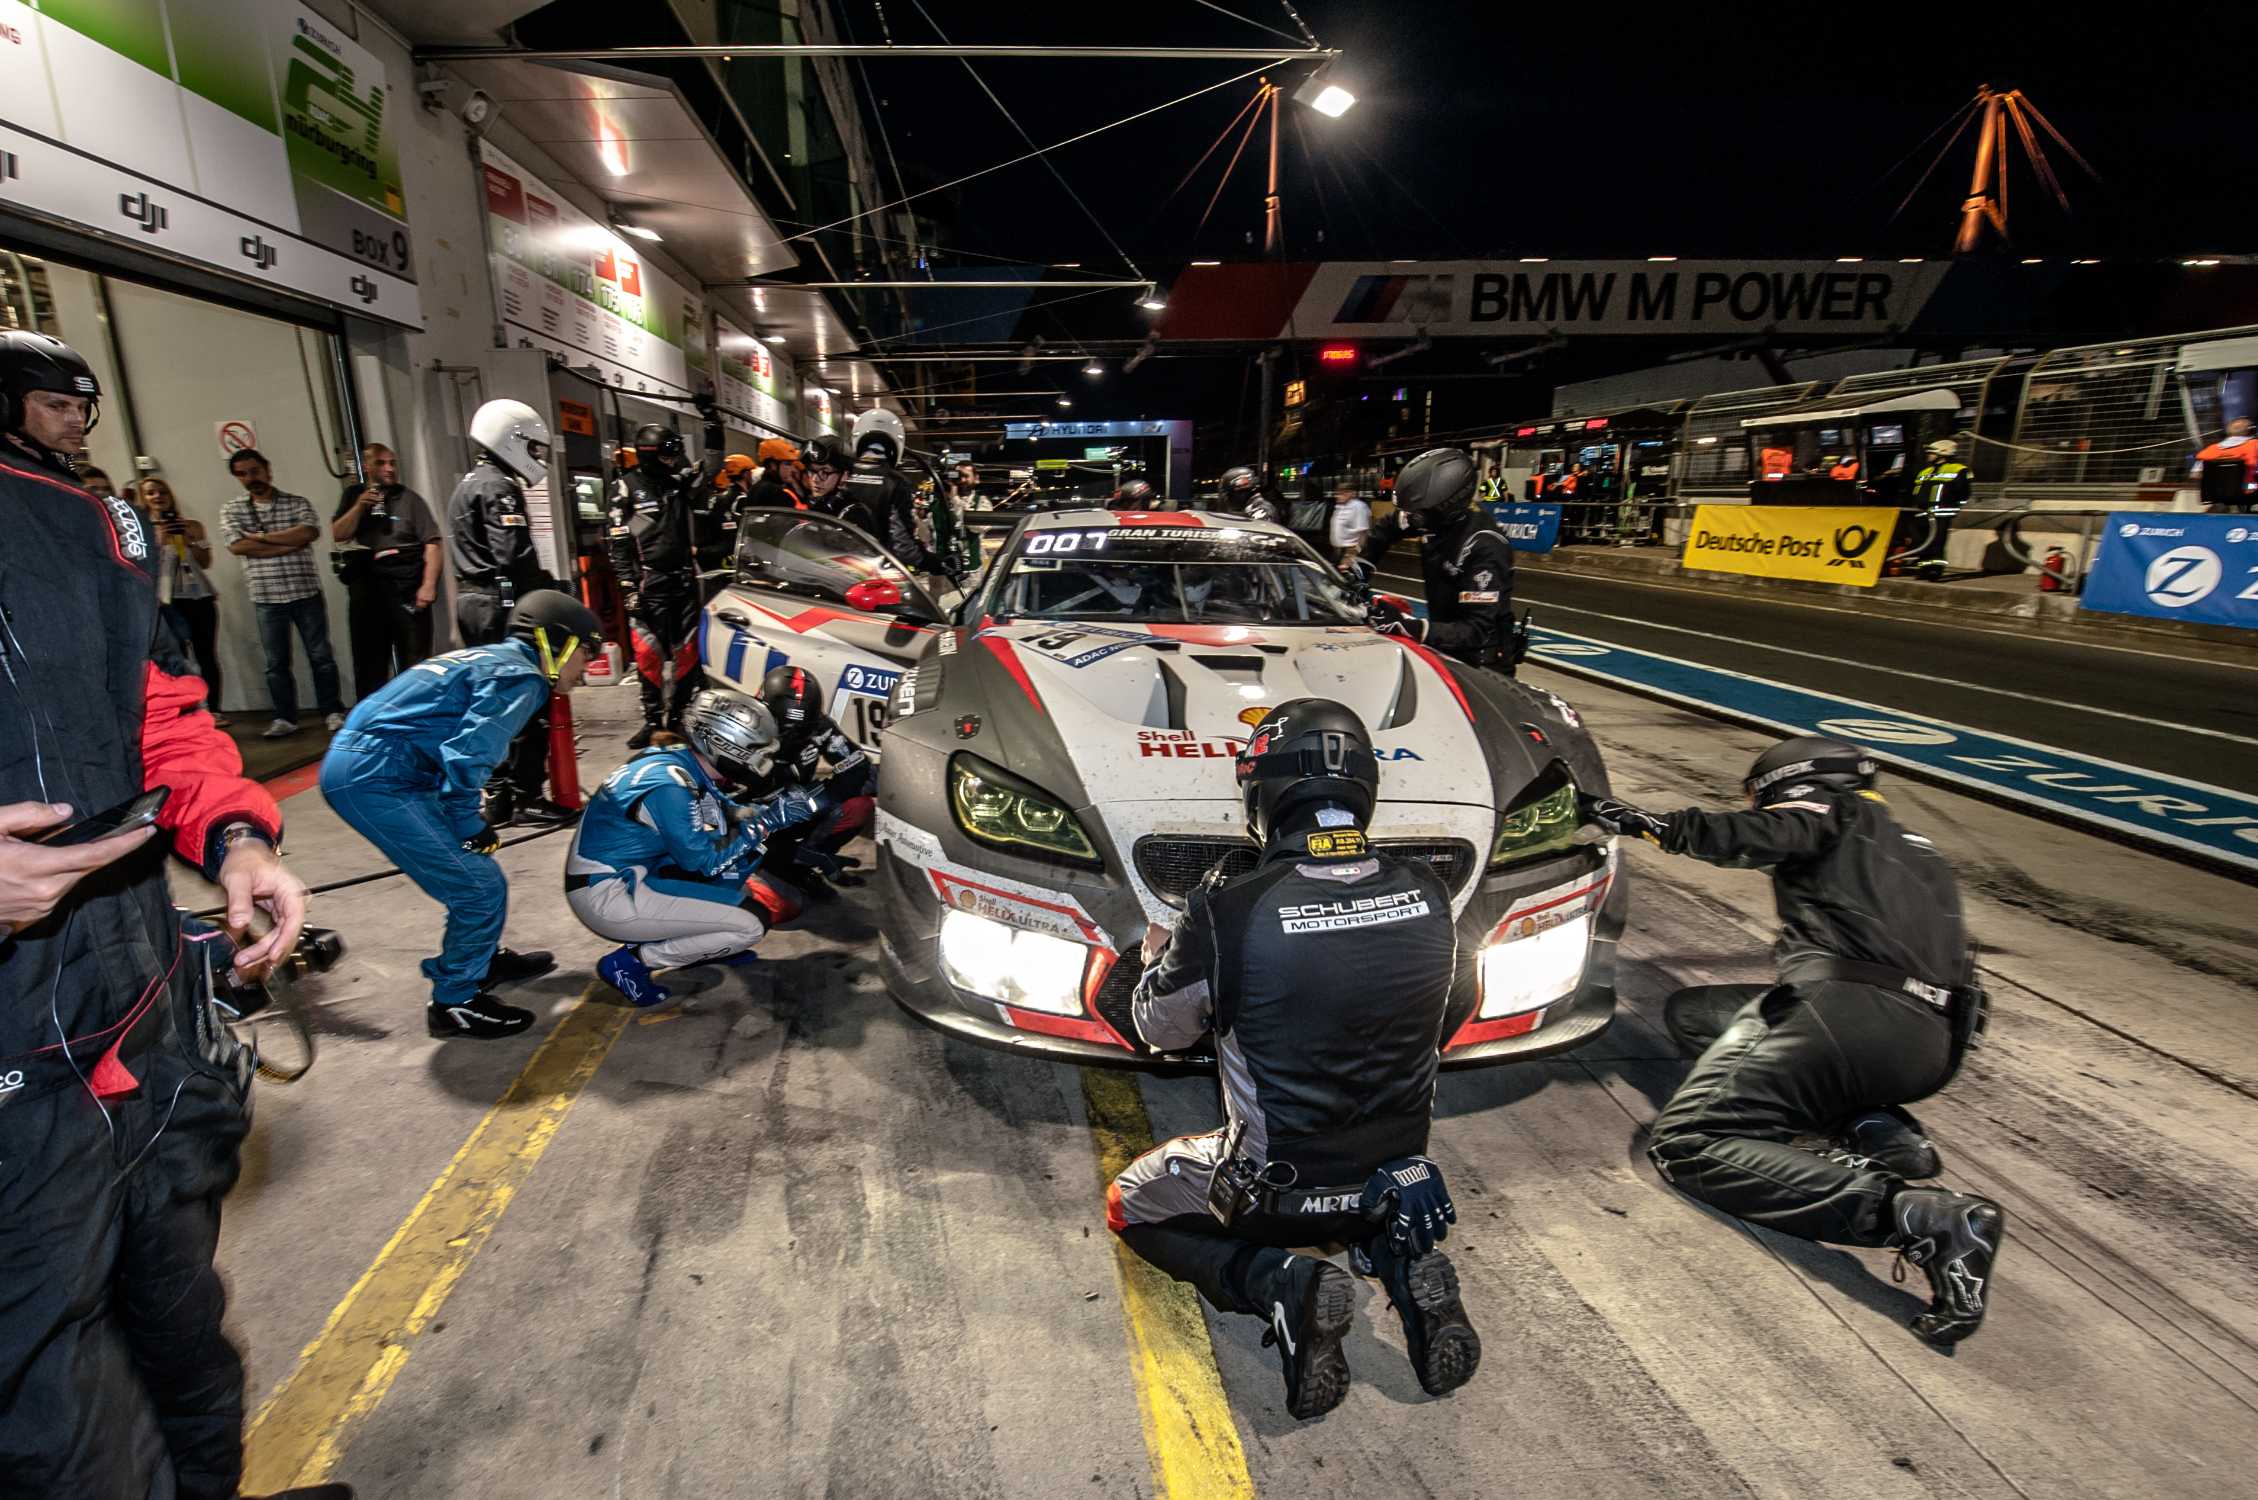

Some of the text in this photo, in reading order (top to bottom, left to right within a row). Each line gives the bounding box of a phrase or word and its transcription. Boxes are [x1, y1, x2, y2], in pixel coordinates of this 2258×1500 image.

[392, 230, 409, 271] 9
[1470, 271, 1892, 322] BMW M POWER
[1052, 424, 1108, 434] HYUNDAI
[1026, 532, 1108, 554] 007
[1107, 528, 1156, 538] GRAN
[1696, 530, 1824, 558] Deutsche Post
[1073, 648, 1108, 666] ADAC
[1137, 730, 1196, 742] Shell
[1138, 742, 1237, 758] HELI
[1278, 889, 1421, 919] SCHUBERT
[1291, 904, 1422, 931] MOTORSPORT
